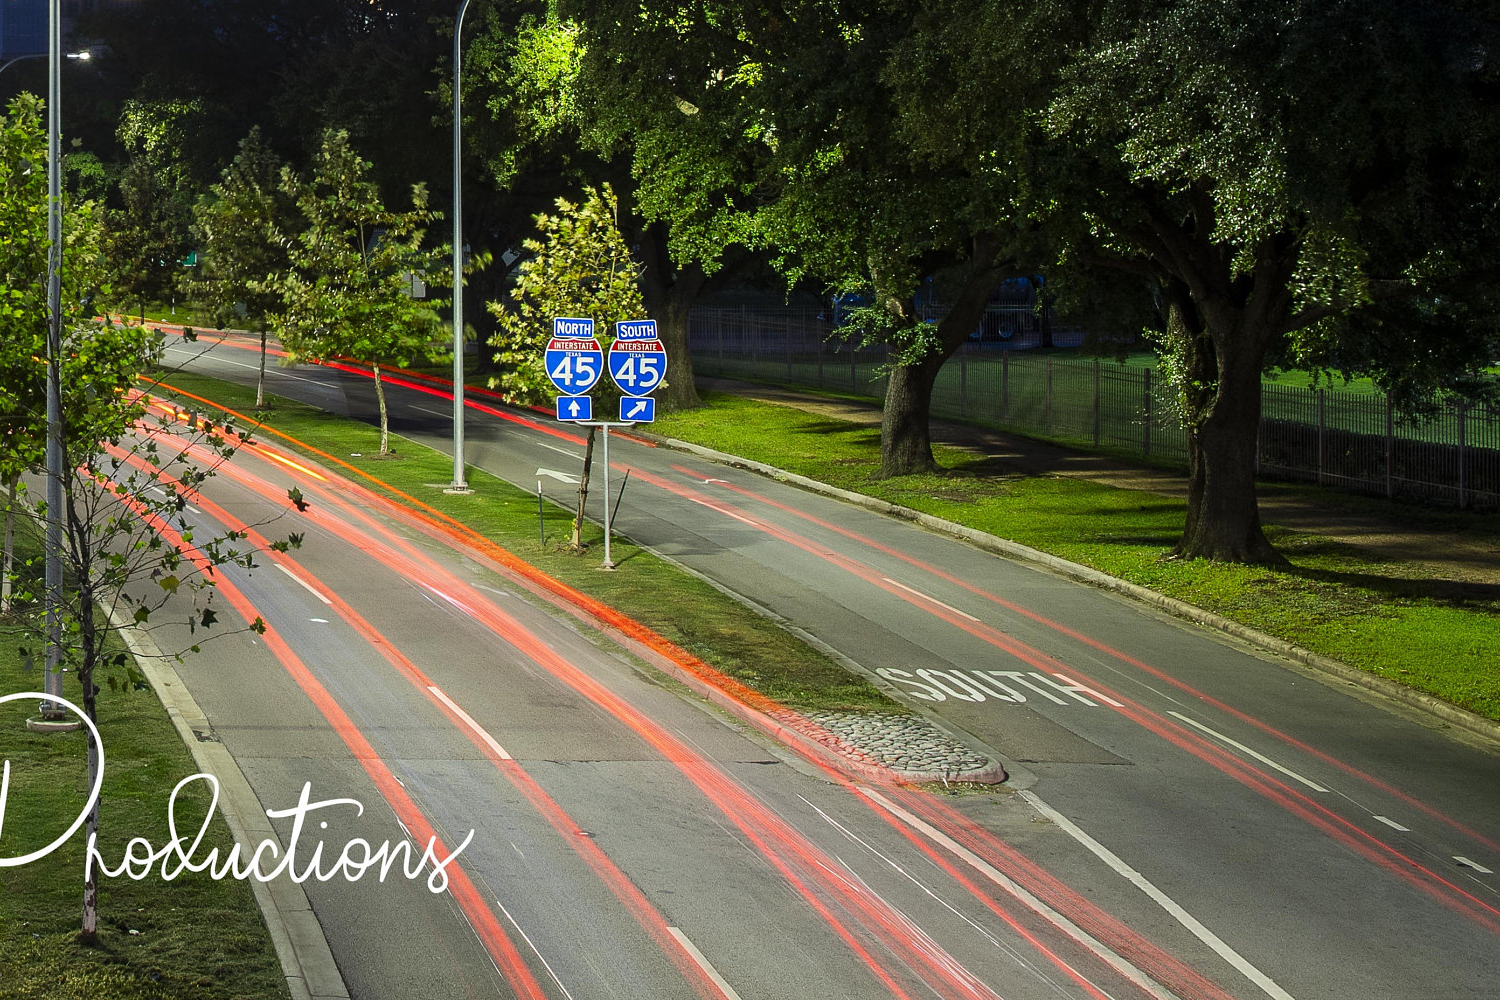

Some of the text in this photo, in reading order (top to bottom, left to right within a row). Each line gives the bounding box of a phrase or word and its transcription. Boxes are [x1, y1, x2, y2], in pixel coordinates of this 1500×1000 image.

[556, 321, 591, 335] NORTH
[620, 325, 655, 338] SOUTH
[553, 341, 594, 350] INTERSTATE
[617, 342, 657, 351] INTERSTATE
[551, 356, 596, 387] 45
[615, 358, 659, 387] 45
[875, 667, 1126, 707] SOUTH
